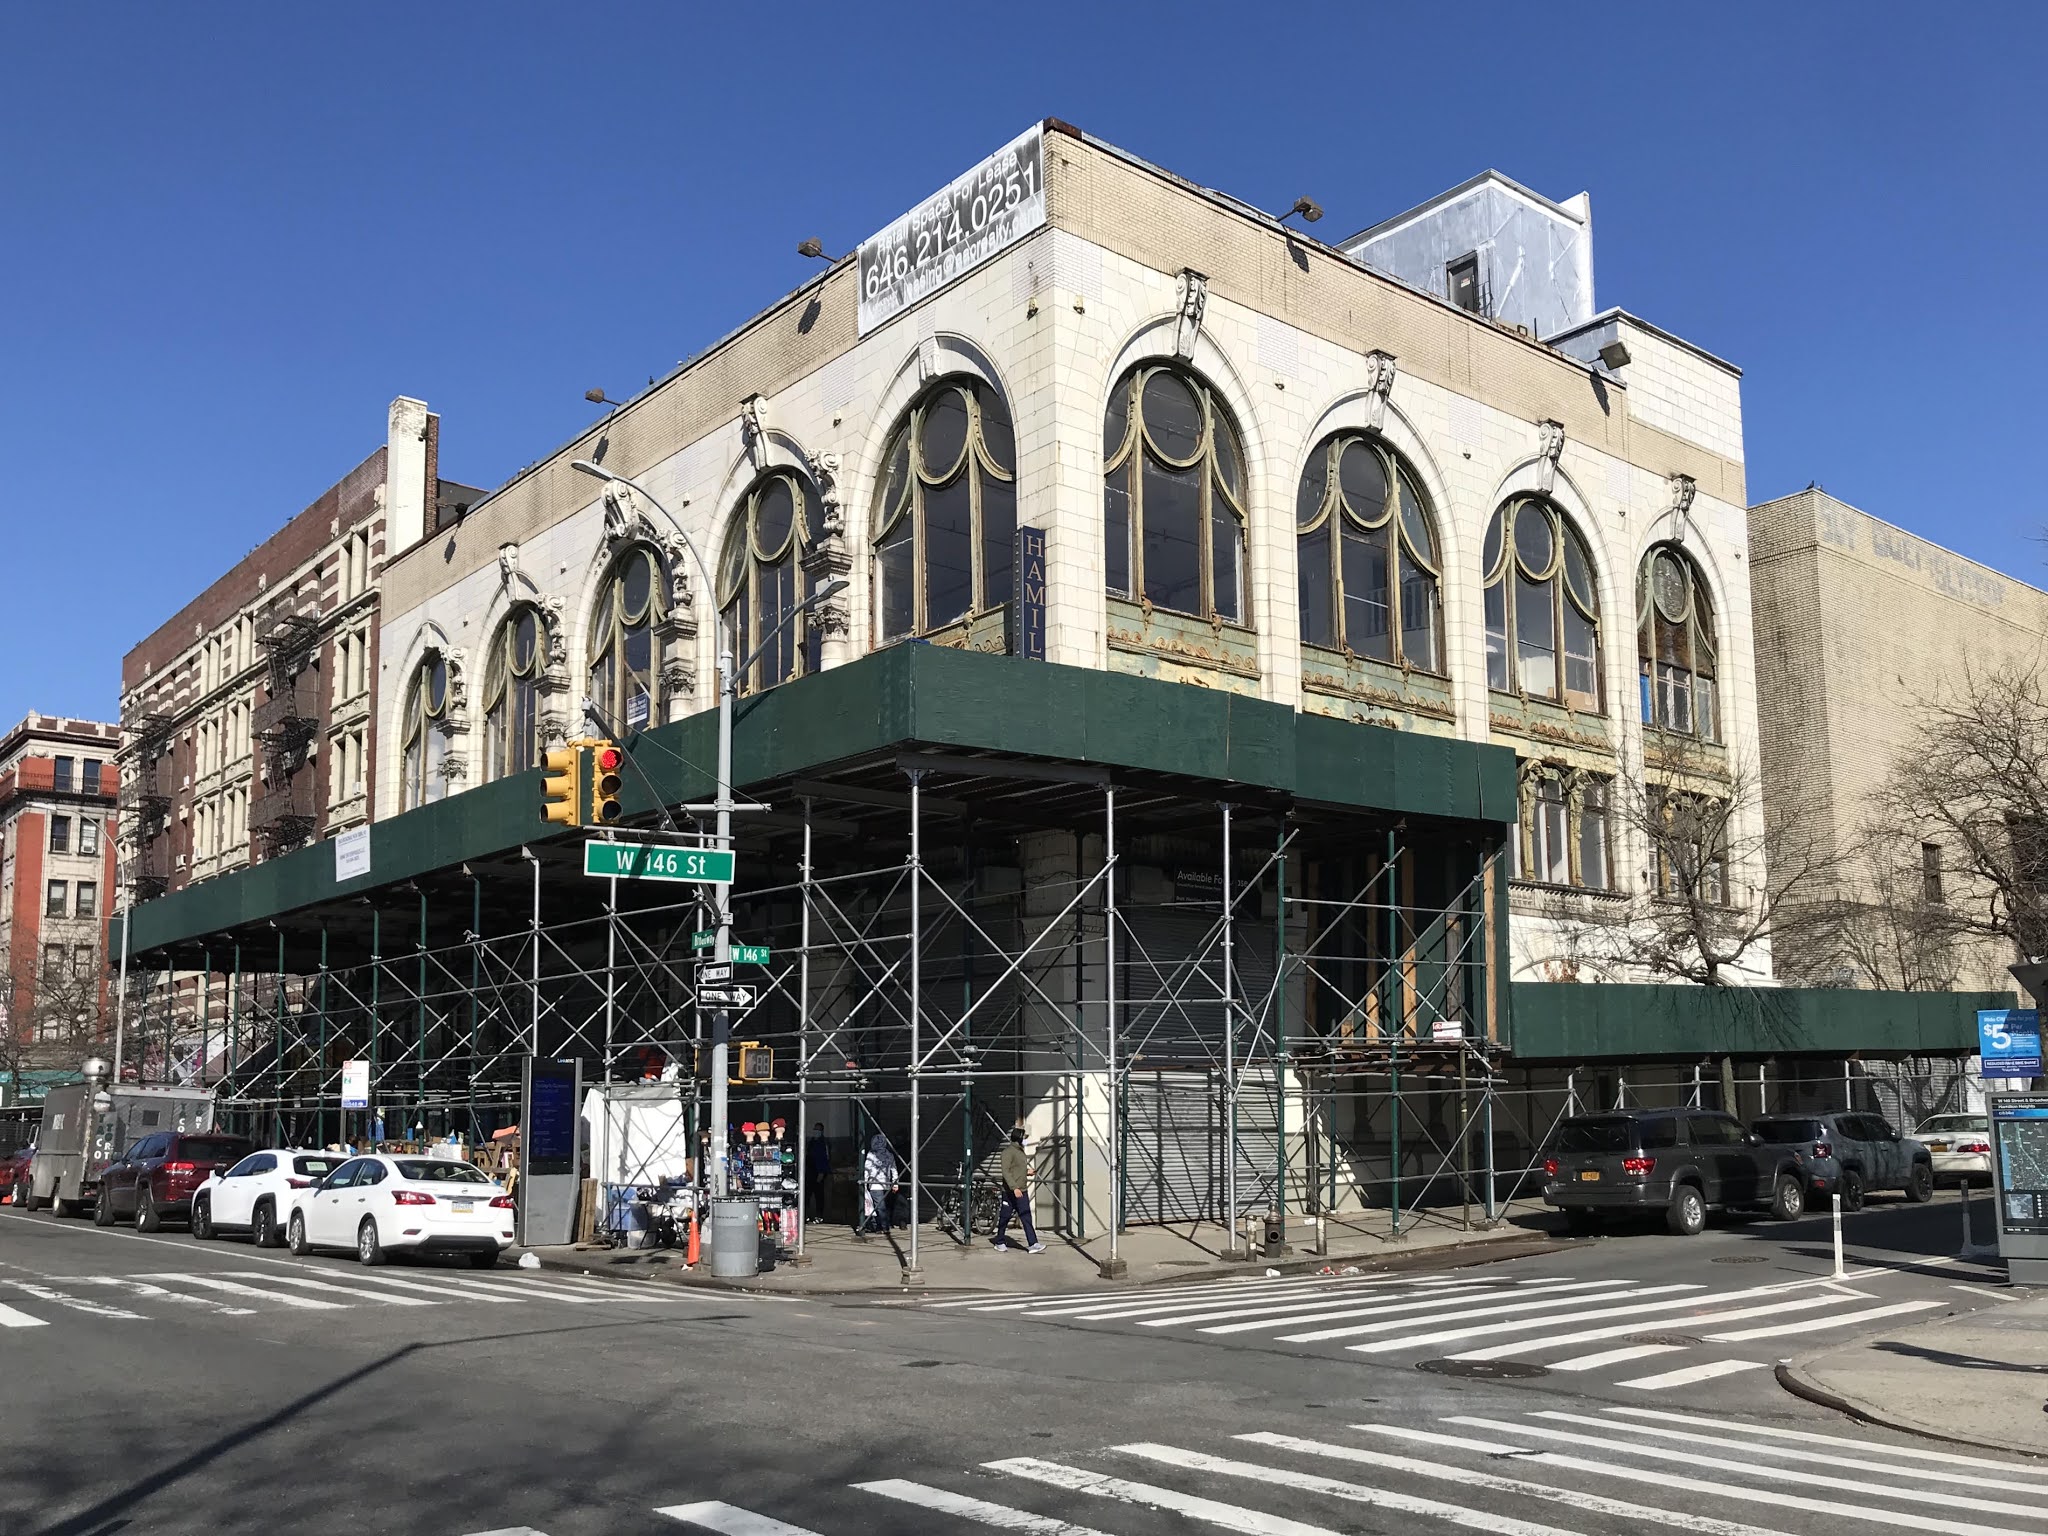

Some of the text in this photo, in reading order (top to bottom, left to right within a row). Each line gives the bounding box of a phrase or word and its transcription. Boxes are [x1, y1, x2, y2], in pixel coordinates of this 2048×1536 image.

[877, 152, 1017, 252] Retail Space For Lease
[866, 161, 1035, 298] 646.214.0251
[1025, 535, 1045, 661] HAMIL
[616, 850, 706, 875] W 146 St
[1177, 870, 1212, 883] Available
[694, 934, 715, 947] Broadway
[732, 947, 767, 962] W 146 St
[701, 968, 728, 979] ONE WAY
[705, 991, 747, 1002] ONE WAY
